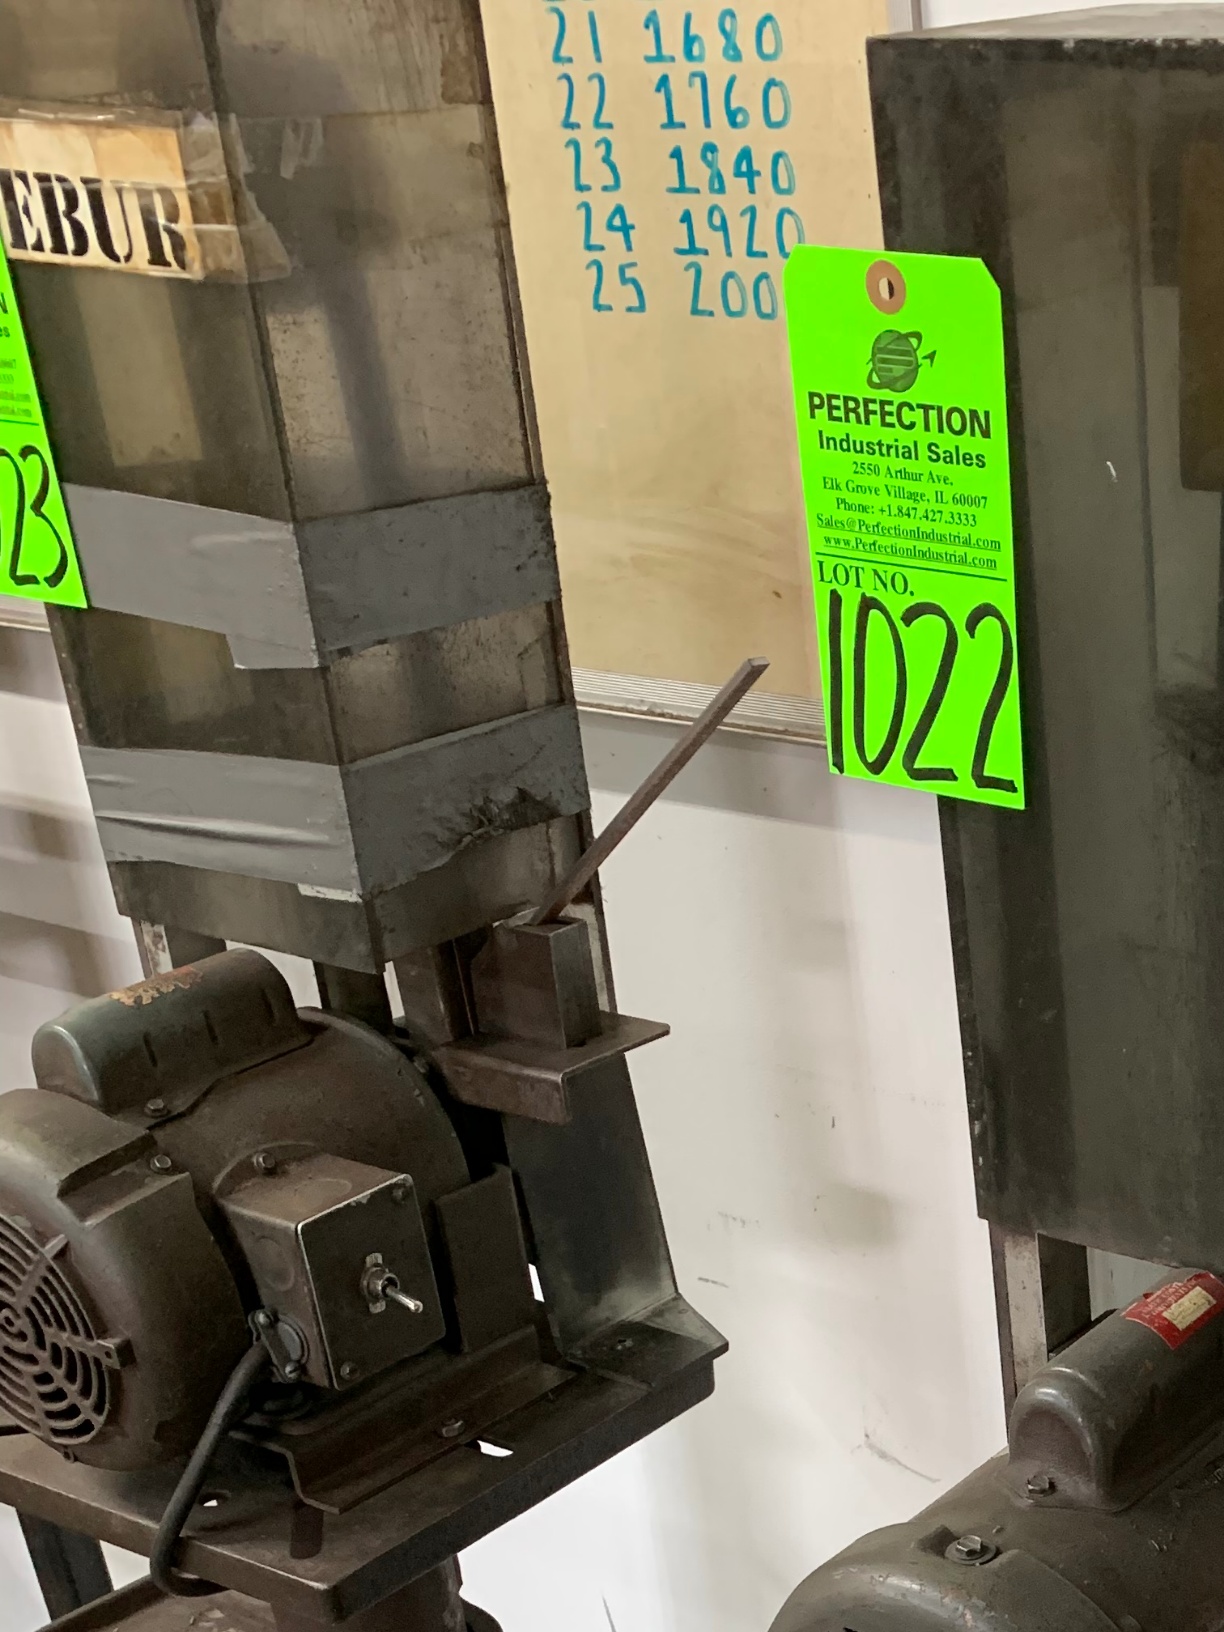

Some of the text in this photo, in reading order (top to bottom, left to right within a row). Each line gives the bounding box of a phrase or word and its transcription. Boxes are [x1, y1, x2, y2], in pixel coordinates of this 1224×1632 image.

[546, 6, 783, 63] 21 1680
[557, 70, 792, 130] 22 1760
[564, 137, 795, 195] 23 1840
[0, 168, 187, 270] EBUR
[576, 201, 805, 259] 24 1920
[585, 258, 646, 313] 25
[807, 391, 992, 439] PERFECTION
[818, 430, 986, 469] Industrial Sales
[852, 461, 953, 486] 2550 Arthur Ave.
[822, 476, 988, 509] Elk Grove Village, IL 60007
[835, 496, 977, 527] Phone: +1.847.427.3333
[816, 513, 1001, 551] Sales@PerfectionIndustrial.com
[823, 535, 997, 569] www.PerfectionIndustrial.com
[817, 560, 915, 597] LOT NO.
[828, 588, 1018, 794] 1022
